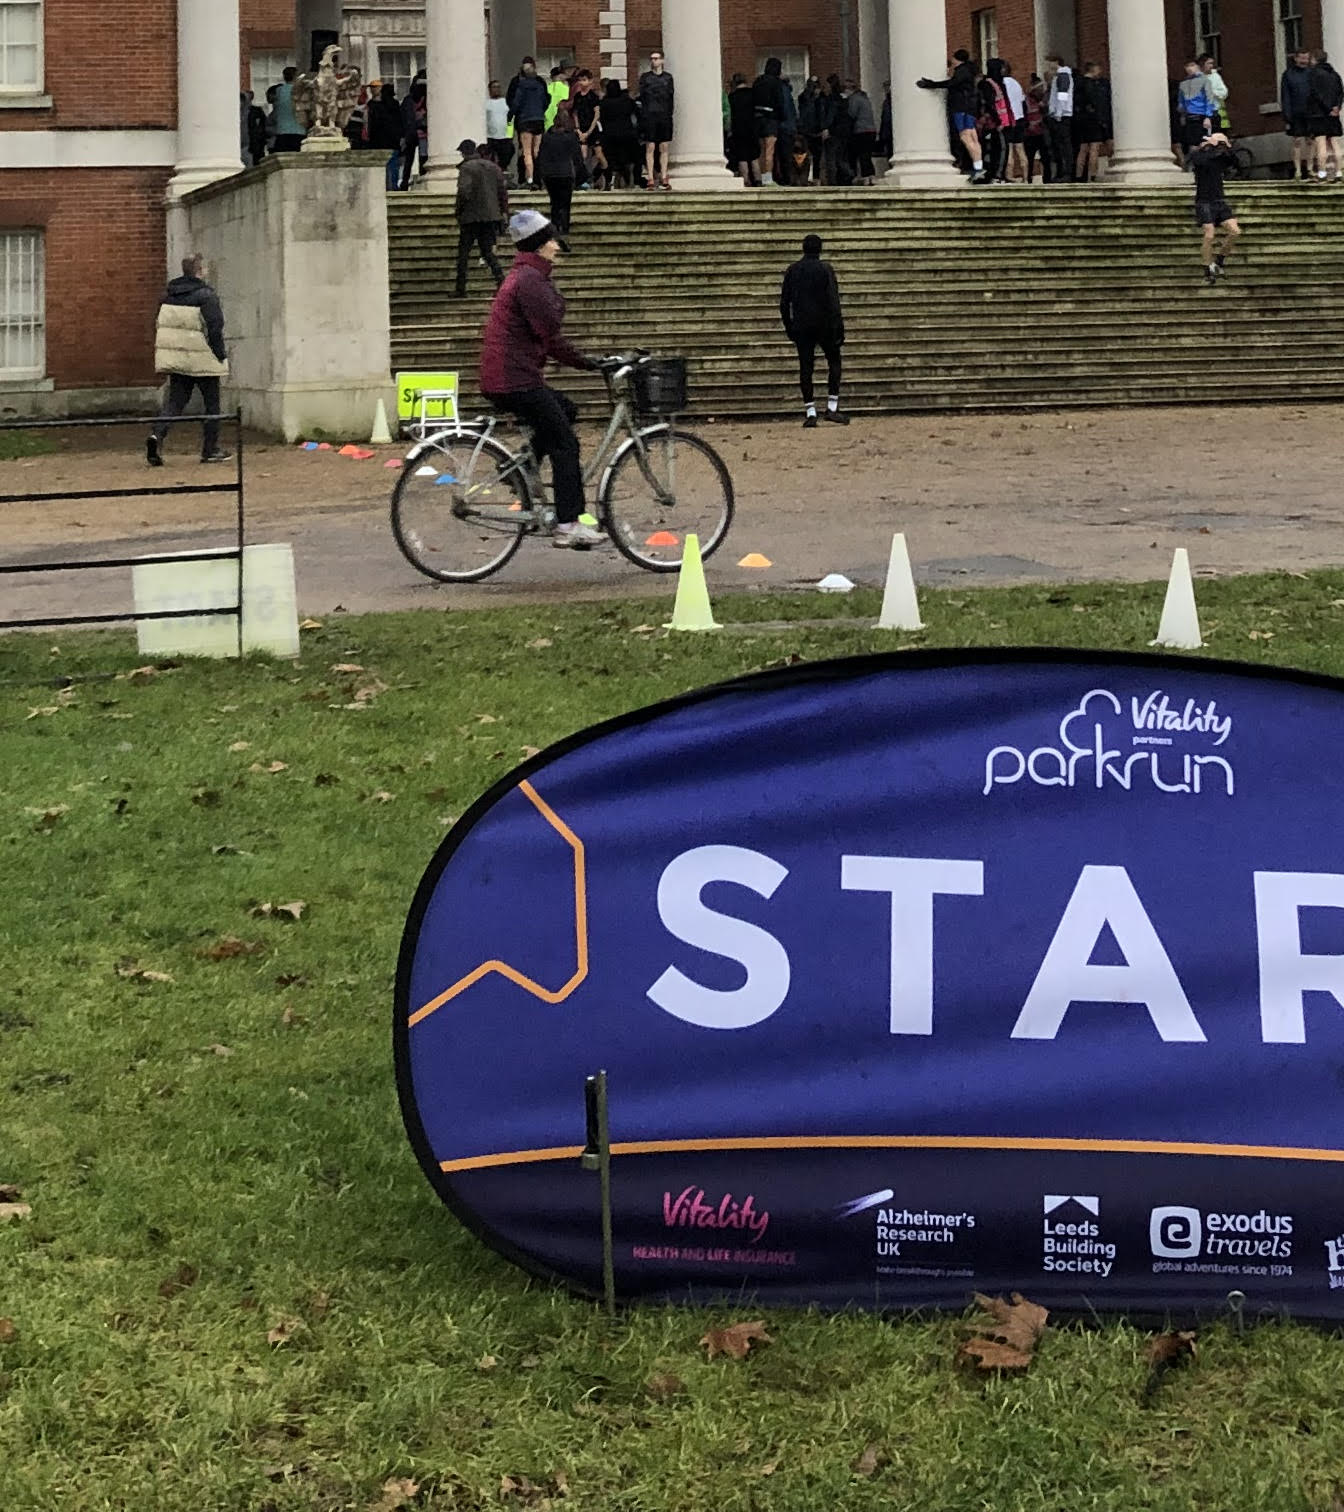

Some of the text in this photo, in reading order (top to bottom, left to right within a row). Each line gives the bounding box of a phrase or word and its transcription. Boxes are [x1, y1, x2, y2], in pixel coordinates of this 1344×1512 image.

[1131, 690, 1232, 745] Vitality
[983, 723, 1233, 795] parkrun
[663, 1185, 769, 1243] Vitality
[877, 1209, 975, 1227] Alzheimer's
[1206, 1210, 1293, 1234] exodus
[877, 1226, 954, 1243] Research
[1044, 1219, 1099, 1236] Leeds
[707, 1248, 730, 1261] LIFE
[877, 1242, 900, 1255] UK
[1044, 1238, 1116, 1259] Building
[1206, 1234, 1292, 1258] travels
[1043, 1255, 1113, 1277] Society
[1152, 1261, 1182, 1273] global
[1184, 1262, 1240, 1274] adventures
[1242, 1264, 1267, 1275] since
